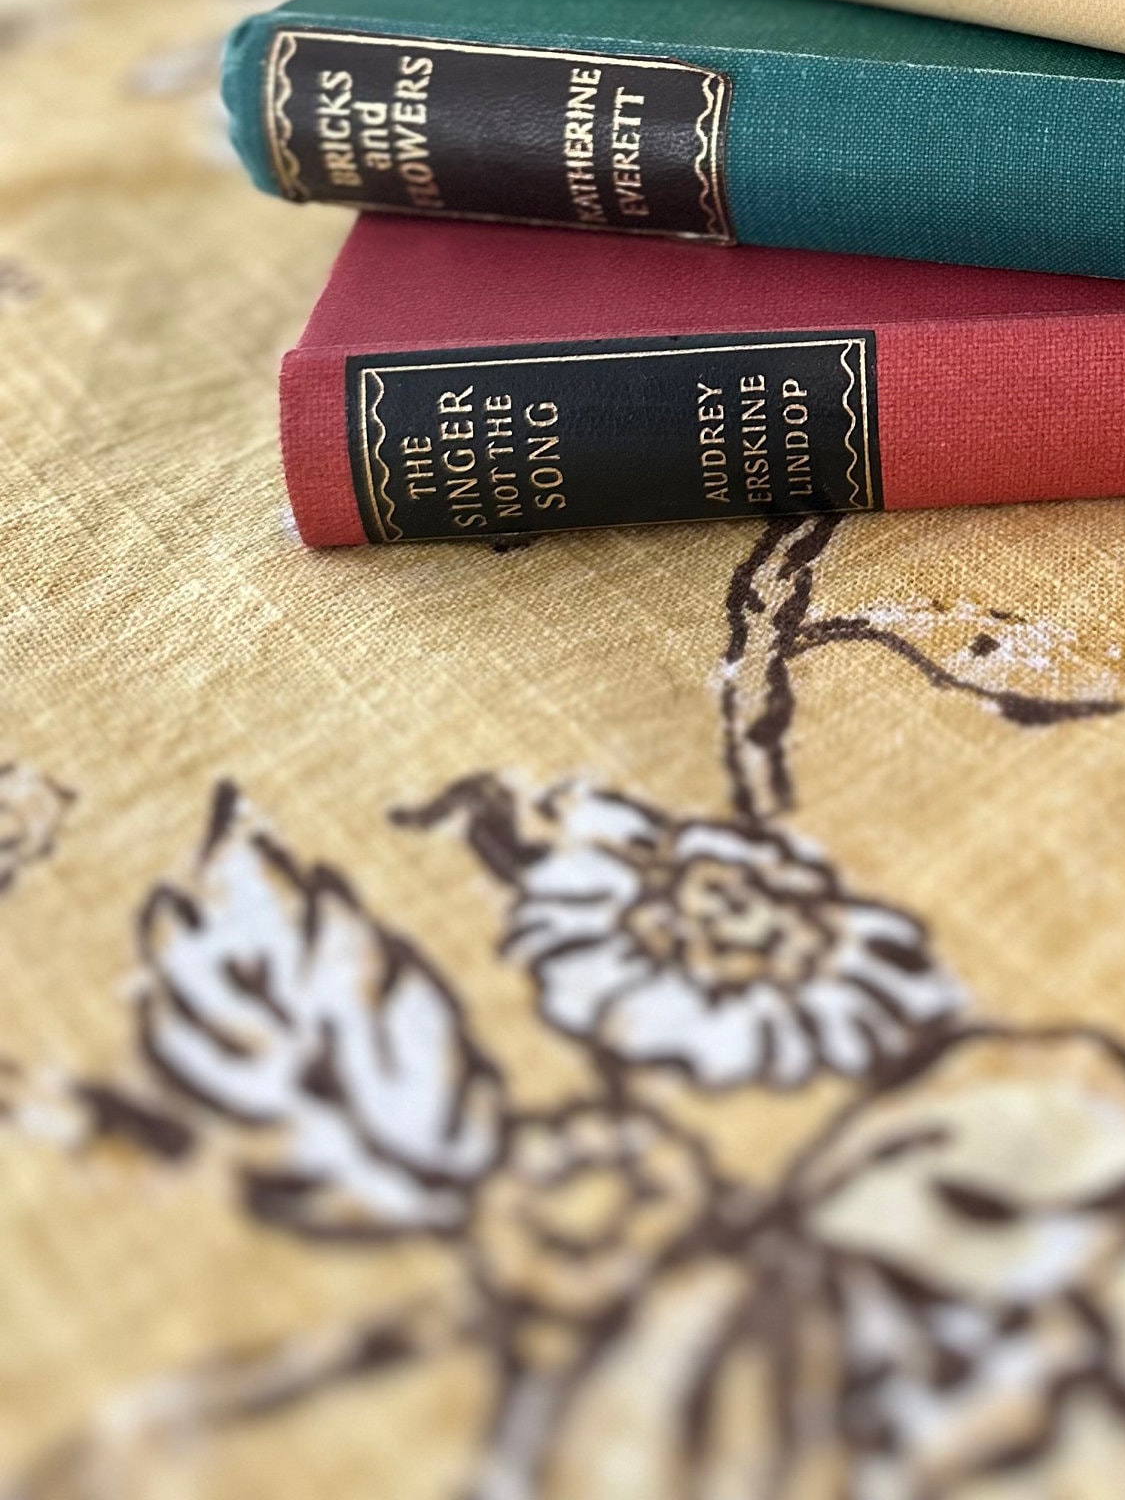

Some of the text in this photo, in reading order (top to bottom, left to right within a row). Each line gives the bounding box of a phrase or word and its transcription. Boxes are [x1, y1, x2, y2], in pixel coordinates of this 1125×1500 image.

[317, 70, 362, 188] BRICKS
[354, 101, 393, 171] and
[563, 67, 602, 222] KATHERINE
[612, 86, 646, 216] EVERETT
[401, 434, 438, 501] THE
[438, 384, 487, 529] SINGER
[484, 393, 524, 518] NOT THE
[523, 401, 567, 510] SONG
[696, 380, 731, 502] AUDREY
[740, 373, 774, 505] ERSKINE
[781, 377, 813, 496] LINDOP
